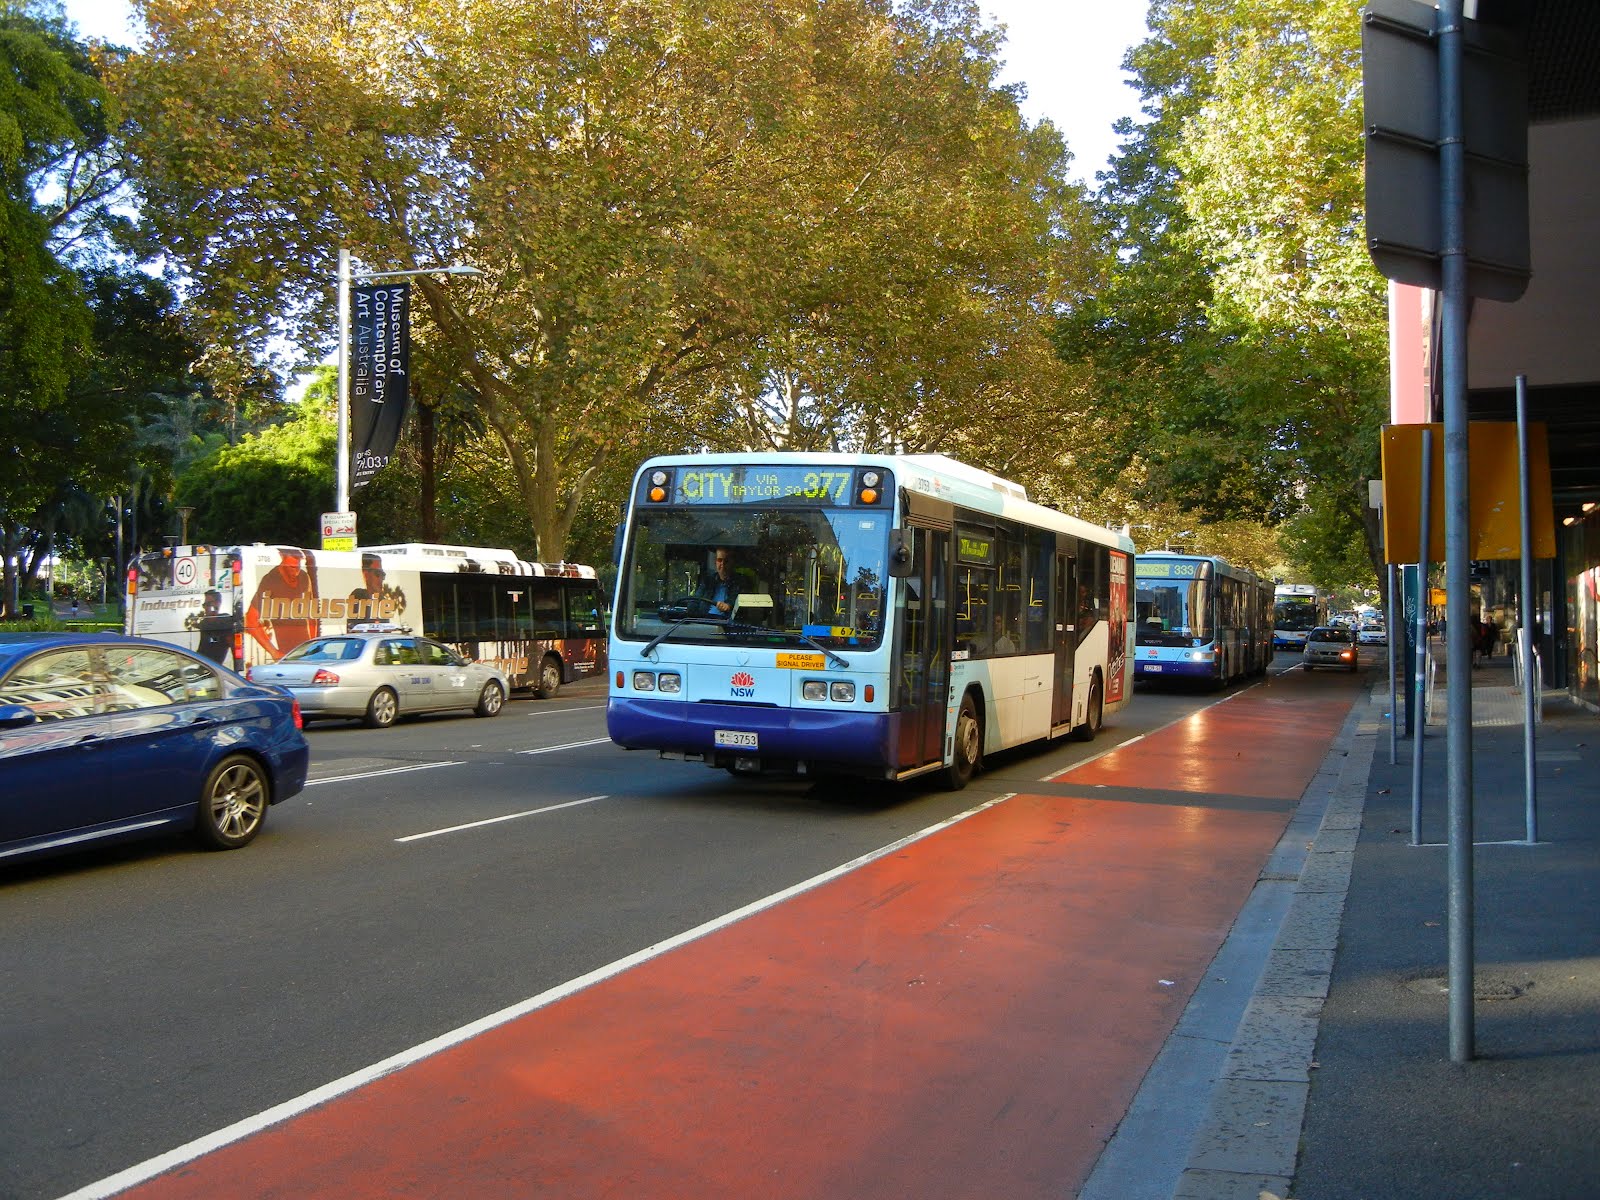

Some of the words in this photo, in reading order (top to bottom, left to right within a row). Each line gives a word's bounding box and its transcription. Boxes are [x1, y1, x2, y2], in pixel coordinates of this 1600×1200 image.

[356, 291, 371, 319] Art
[390, 288, 404, 355] Museum
[370, 289, 389, 404] Contemporary
[355, 324, 370, 396] Australia
[390, 356, 405, 376] of
[683, 472, 734, 498] CITY
[803, 472, 850, 498] 377
[756, 474, 778, 485] VIA
[733, 485, 781, 496] TAYLOR
[178, 564, 192, 578] 40
[1174, 565, 1194, 576] 333
[140, 597, 201, 611] industrie
[260, 592, 396, 620] industrie
[730, 687, 755, 698] NSW
[733, 734, 757, 746] 3753
